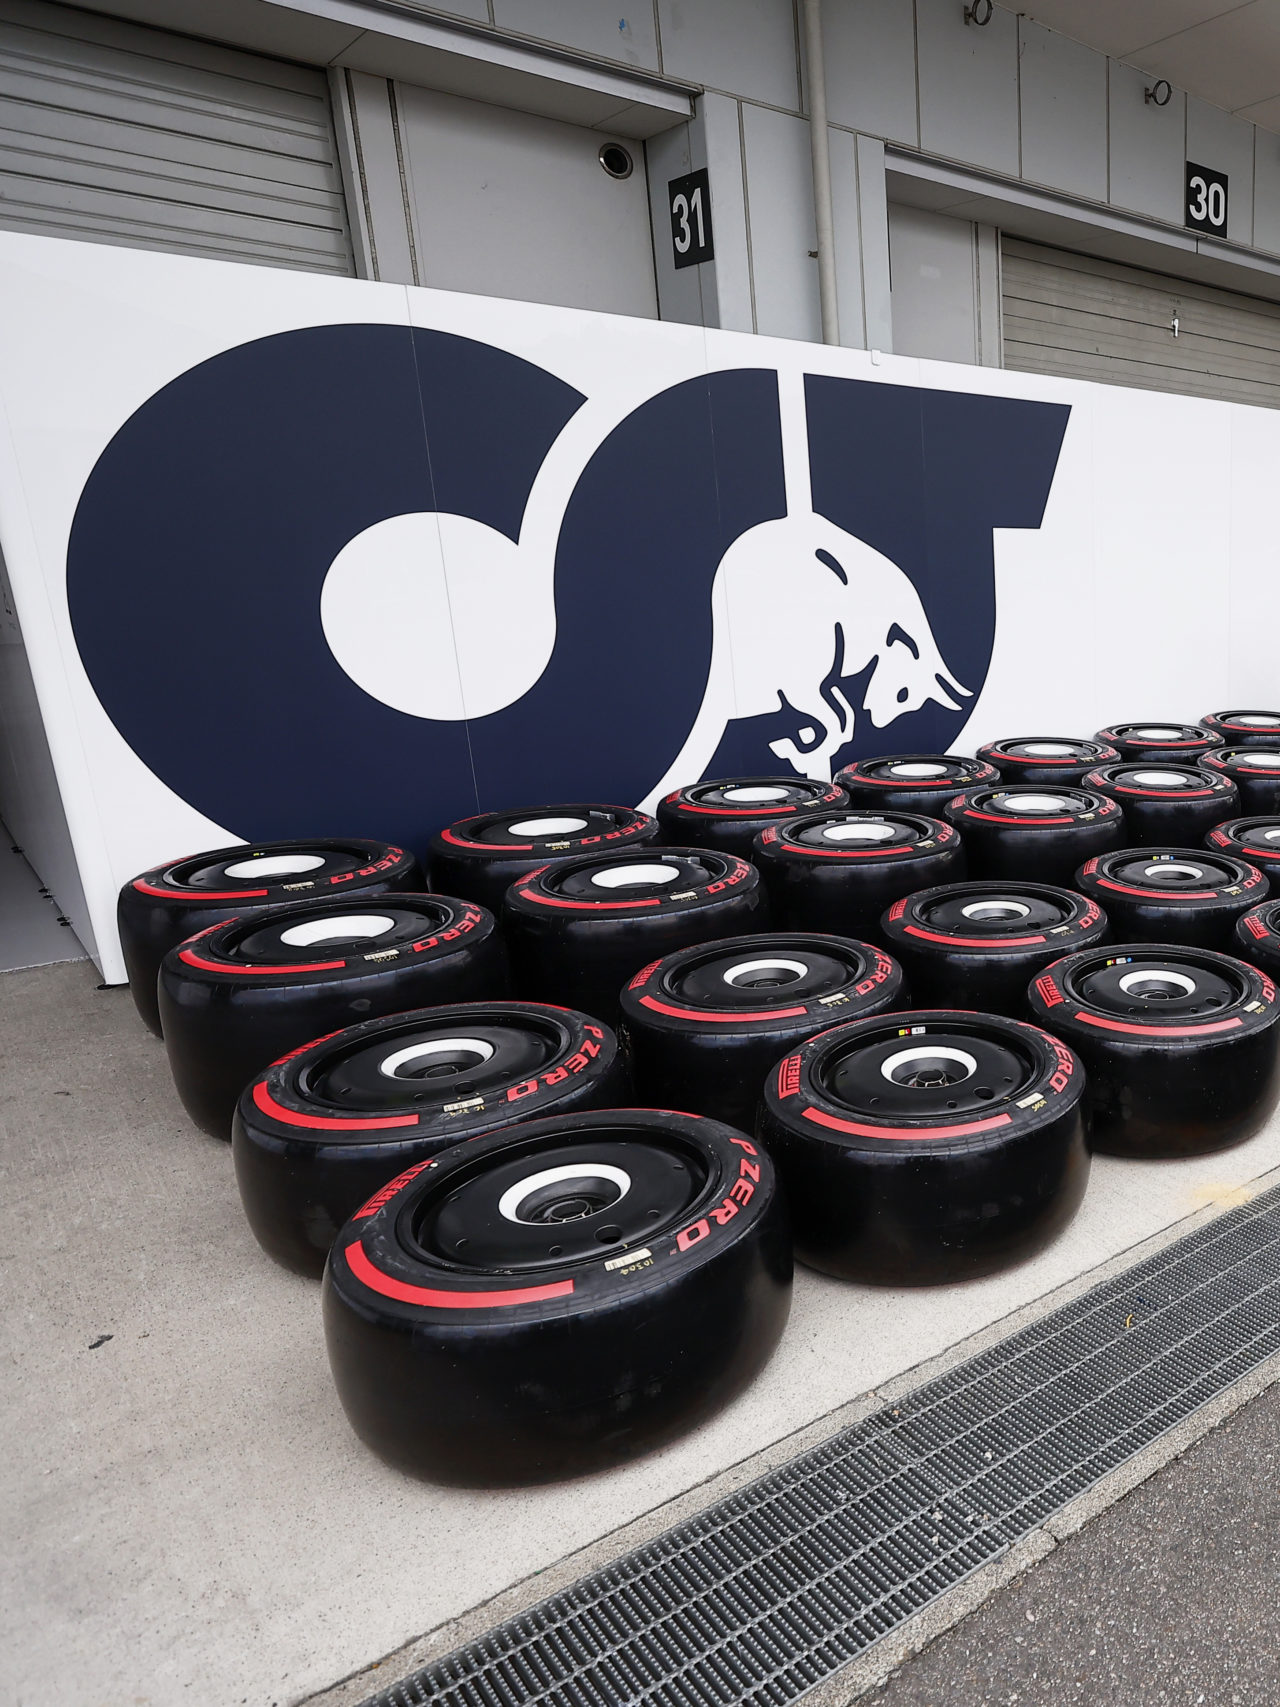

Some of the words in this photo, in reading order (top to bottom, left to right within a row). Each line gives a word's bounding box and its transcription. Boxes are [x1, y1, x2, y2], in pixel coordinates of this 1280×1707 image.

[672, 187, 705, 254] 31
[1189, 176, 1226, 227] 30
[580, 823, 647, 845] ZERO
[330, 854, 402, 884] ZERO
[412, 911, 482, 952] ZERO
[628, 959, 664, 991] PIRELLI
[1035, 975, 1065, 1008] PIRELLI
[584, 1025, 604, 1039] P
[506, 1039, 602, 1102] ZERO
[778, 1055, 802, 1099] PIRELLI
[1041, 1033, 1074, 1093] ZERO
[729, 1138, 759, 1155] P
[352, 1159, 434, 1221] PIRELLI
[676, 1158, 760, 1252] ZERO
